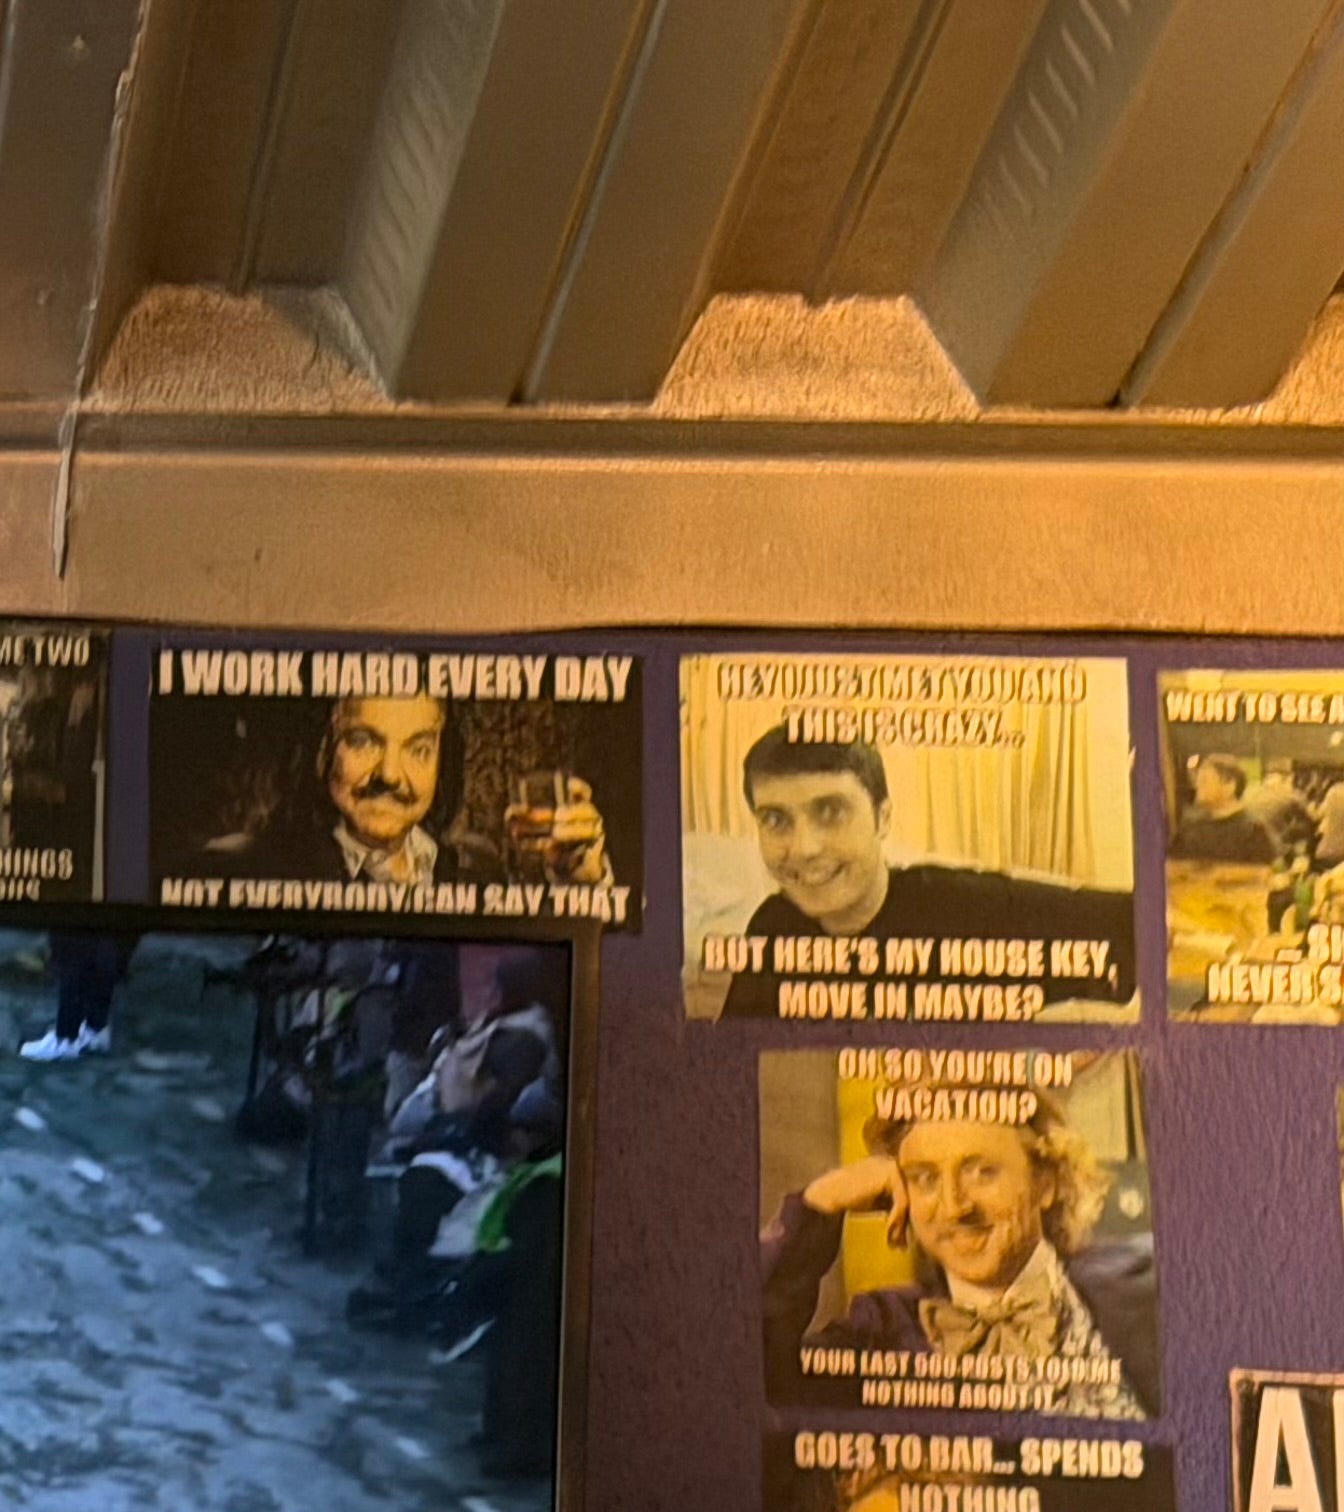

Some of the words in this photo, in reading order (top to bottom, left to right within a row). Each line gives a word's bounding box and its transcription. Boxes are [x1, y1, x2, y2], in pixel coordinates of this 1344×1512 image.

[33, 635, 90, 667] TWO
[159, 650, 173, 695] I
[181, 650, 303, 696] WORK
[311, 651, 419, 697] HARD
[428, 654, 548, 700] EVERY
[554, 656, 633, 702] DAY
[718, 661, 778, 699] HEY
[781, 662, 797, 700] I
[800, 662, 875, 701] JUST
[879, 664, 944, 702] MET
[948, 665, 1017, 703] YOU
[1020, 666, 1087, 704] AND
[782, 706, 857, 744] THIS
[861, 706, 896, 746] IS
[1167, 690, 1242, 722] WENT
[1245, 692, 1278, 723] TO
[1280, 692, 1325, 724] SEE
[162, 878, 224, 906] NOT
[229, 879, 408, 912] EVERYBODY
[414, 882, 477, 914] CAN
[483, 883, 544, 916] SAY
[548, 885, 631, 923] THAT
[704, 936, 767, 973] BUT
[774, 936, 879, 976] HERE'S
[885, 938, 935, 975] MY
[940, 940, 1044, 977] HOUSE
[1050, 941, 1118, 990] KEY,
[1208, 963, 1313, 1003] NEVER
[779, 982, 868, 1020] MOVE
[873, 983, 907, 1019] IN
[914, 984, 1044, 1021] MAYBE?
[839, 1048, 877, 1080] OH
[885, 1047, 922, 1083] SO
[929, 1049, 1028, 1086] YOU'RE
[1034, 1053, 1073, 1088] ON
[875, 1086, 1038, 1124] VACATION?
[800, 1348, 855, 1377] YOUR
[861, 1350, 910, 1378] LAST
[962, 1353, 1029, 1381] POSTS
[1035, 1355, 1087, 1383] TOLD
[1090, 1357, 1122, 1385] ME
[862, 1379, 955, 1407] NOTHING
[959, 1382, 1029, 1411] ABOUT
[794, 1431, 875, 1469] GOES
[880, 1433, 922, 1471] TO
[929, 1435, 1015, 1474] BAR...
[1020, 1437, 1145, 1478] SPENDS
